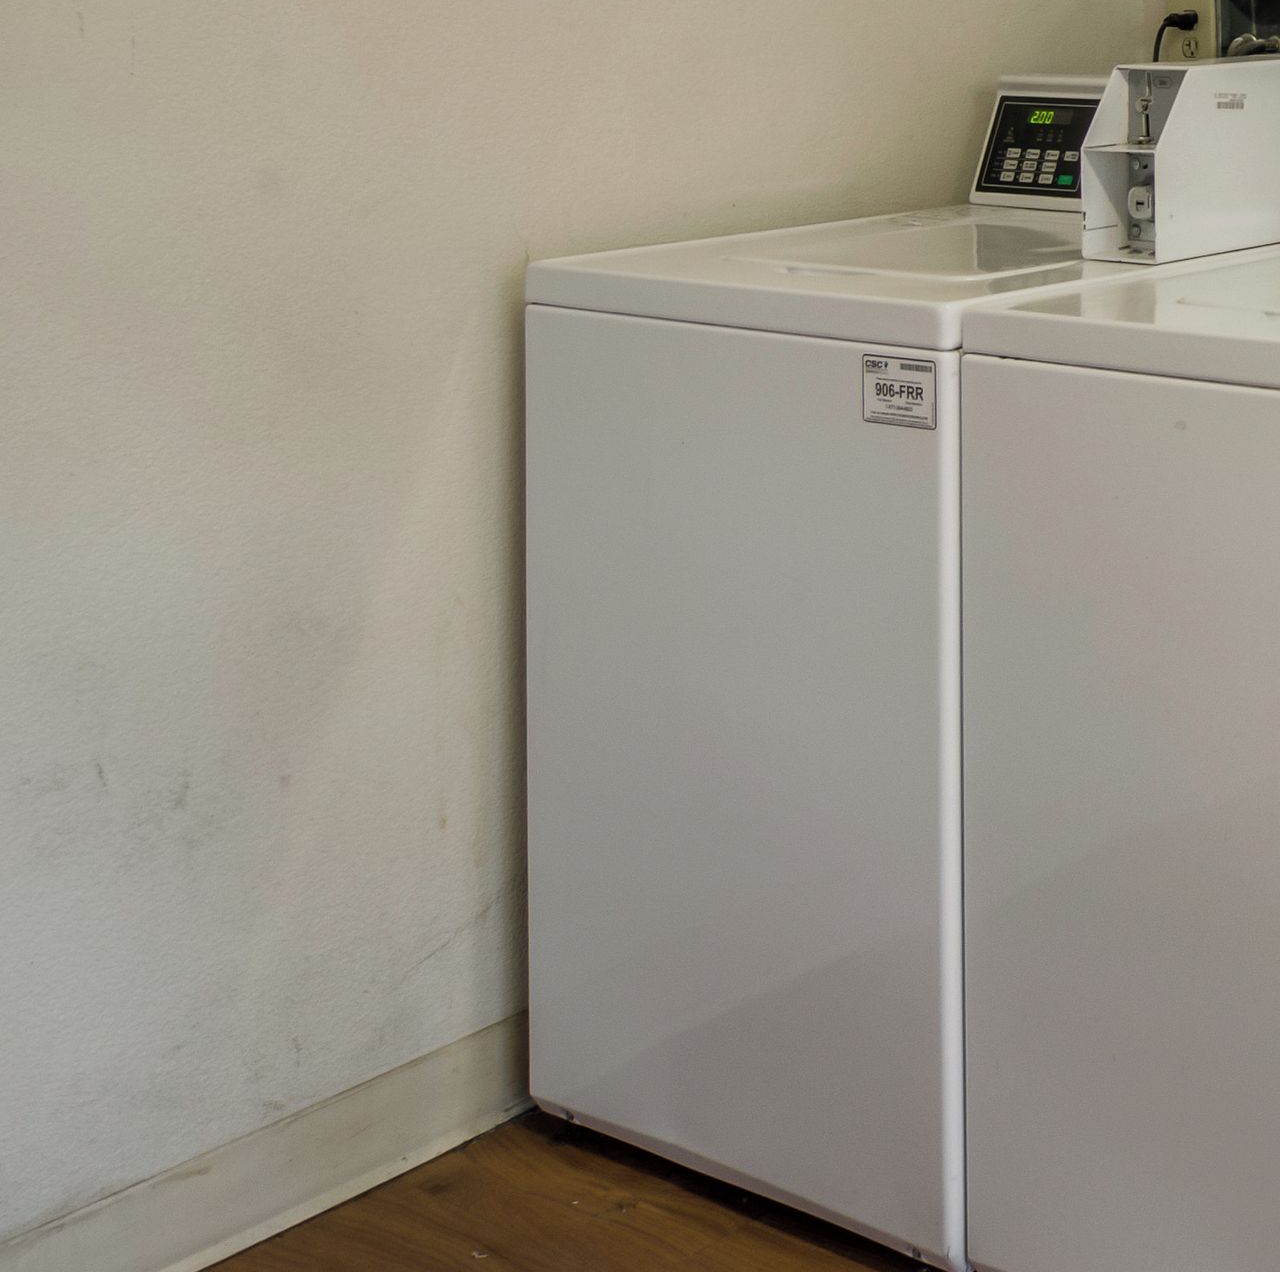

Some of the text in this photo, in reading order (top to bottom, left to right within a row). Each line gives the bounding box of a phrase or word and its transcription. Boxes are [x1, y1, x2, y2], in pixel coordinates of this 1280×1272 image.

[1030, 111, 1055, 123] 2.00
[865, 360, 882, 368] CSC
[875, 383, 923, 400] 906-FRR
